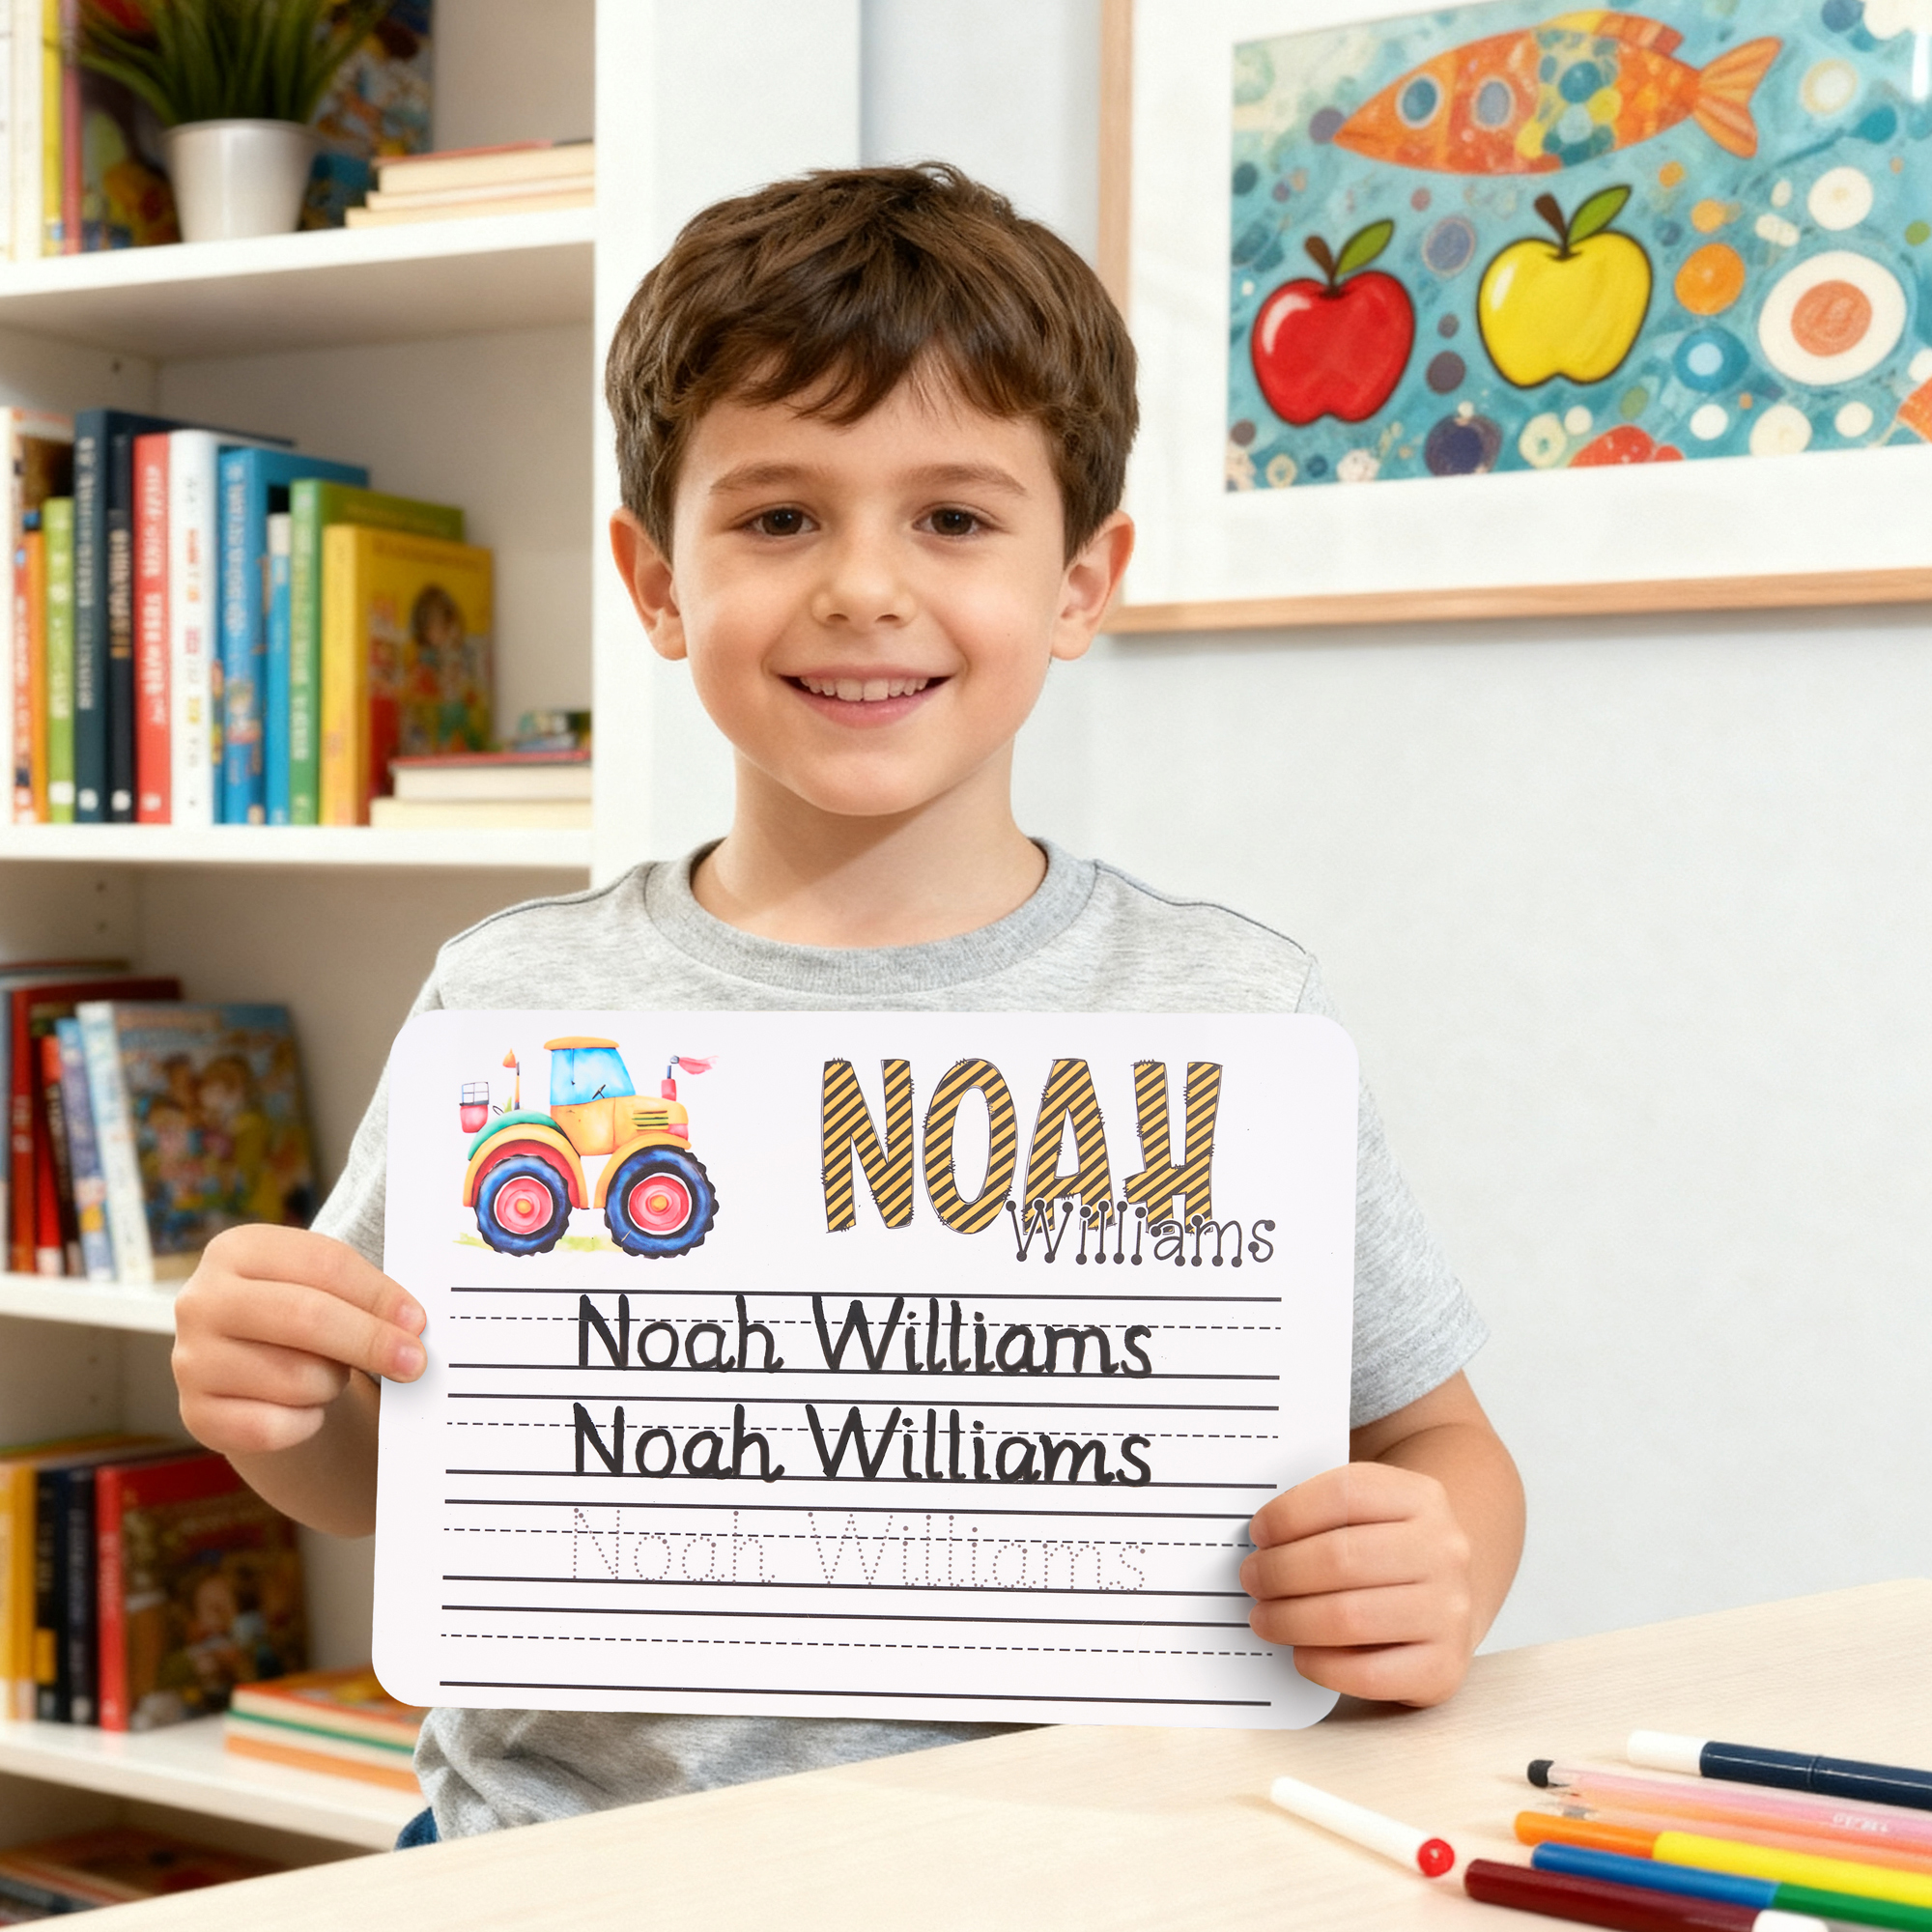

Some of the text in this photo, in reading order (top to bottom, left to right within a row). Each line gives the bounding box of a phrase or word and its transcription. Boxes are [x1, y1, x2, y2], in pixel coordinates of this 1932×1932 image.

[822, 1058, 1223, 1234] NOAH
[1006, 1201, 1275, 1267] Williams
[579, 1293, 1152, 1376] Noah Williams
[574, 1403, 1151, 1487] Noah Williams
[574, 1508, 1146, 1591] Noah Williams
